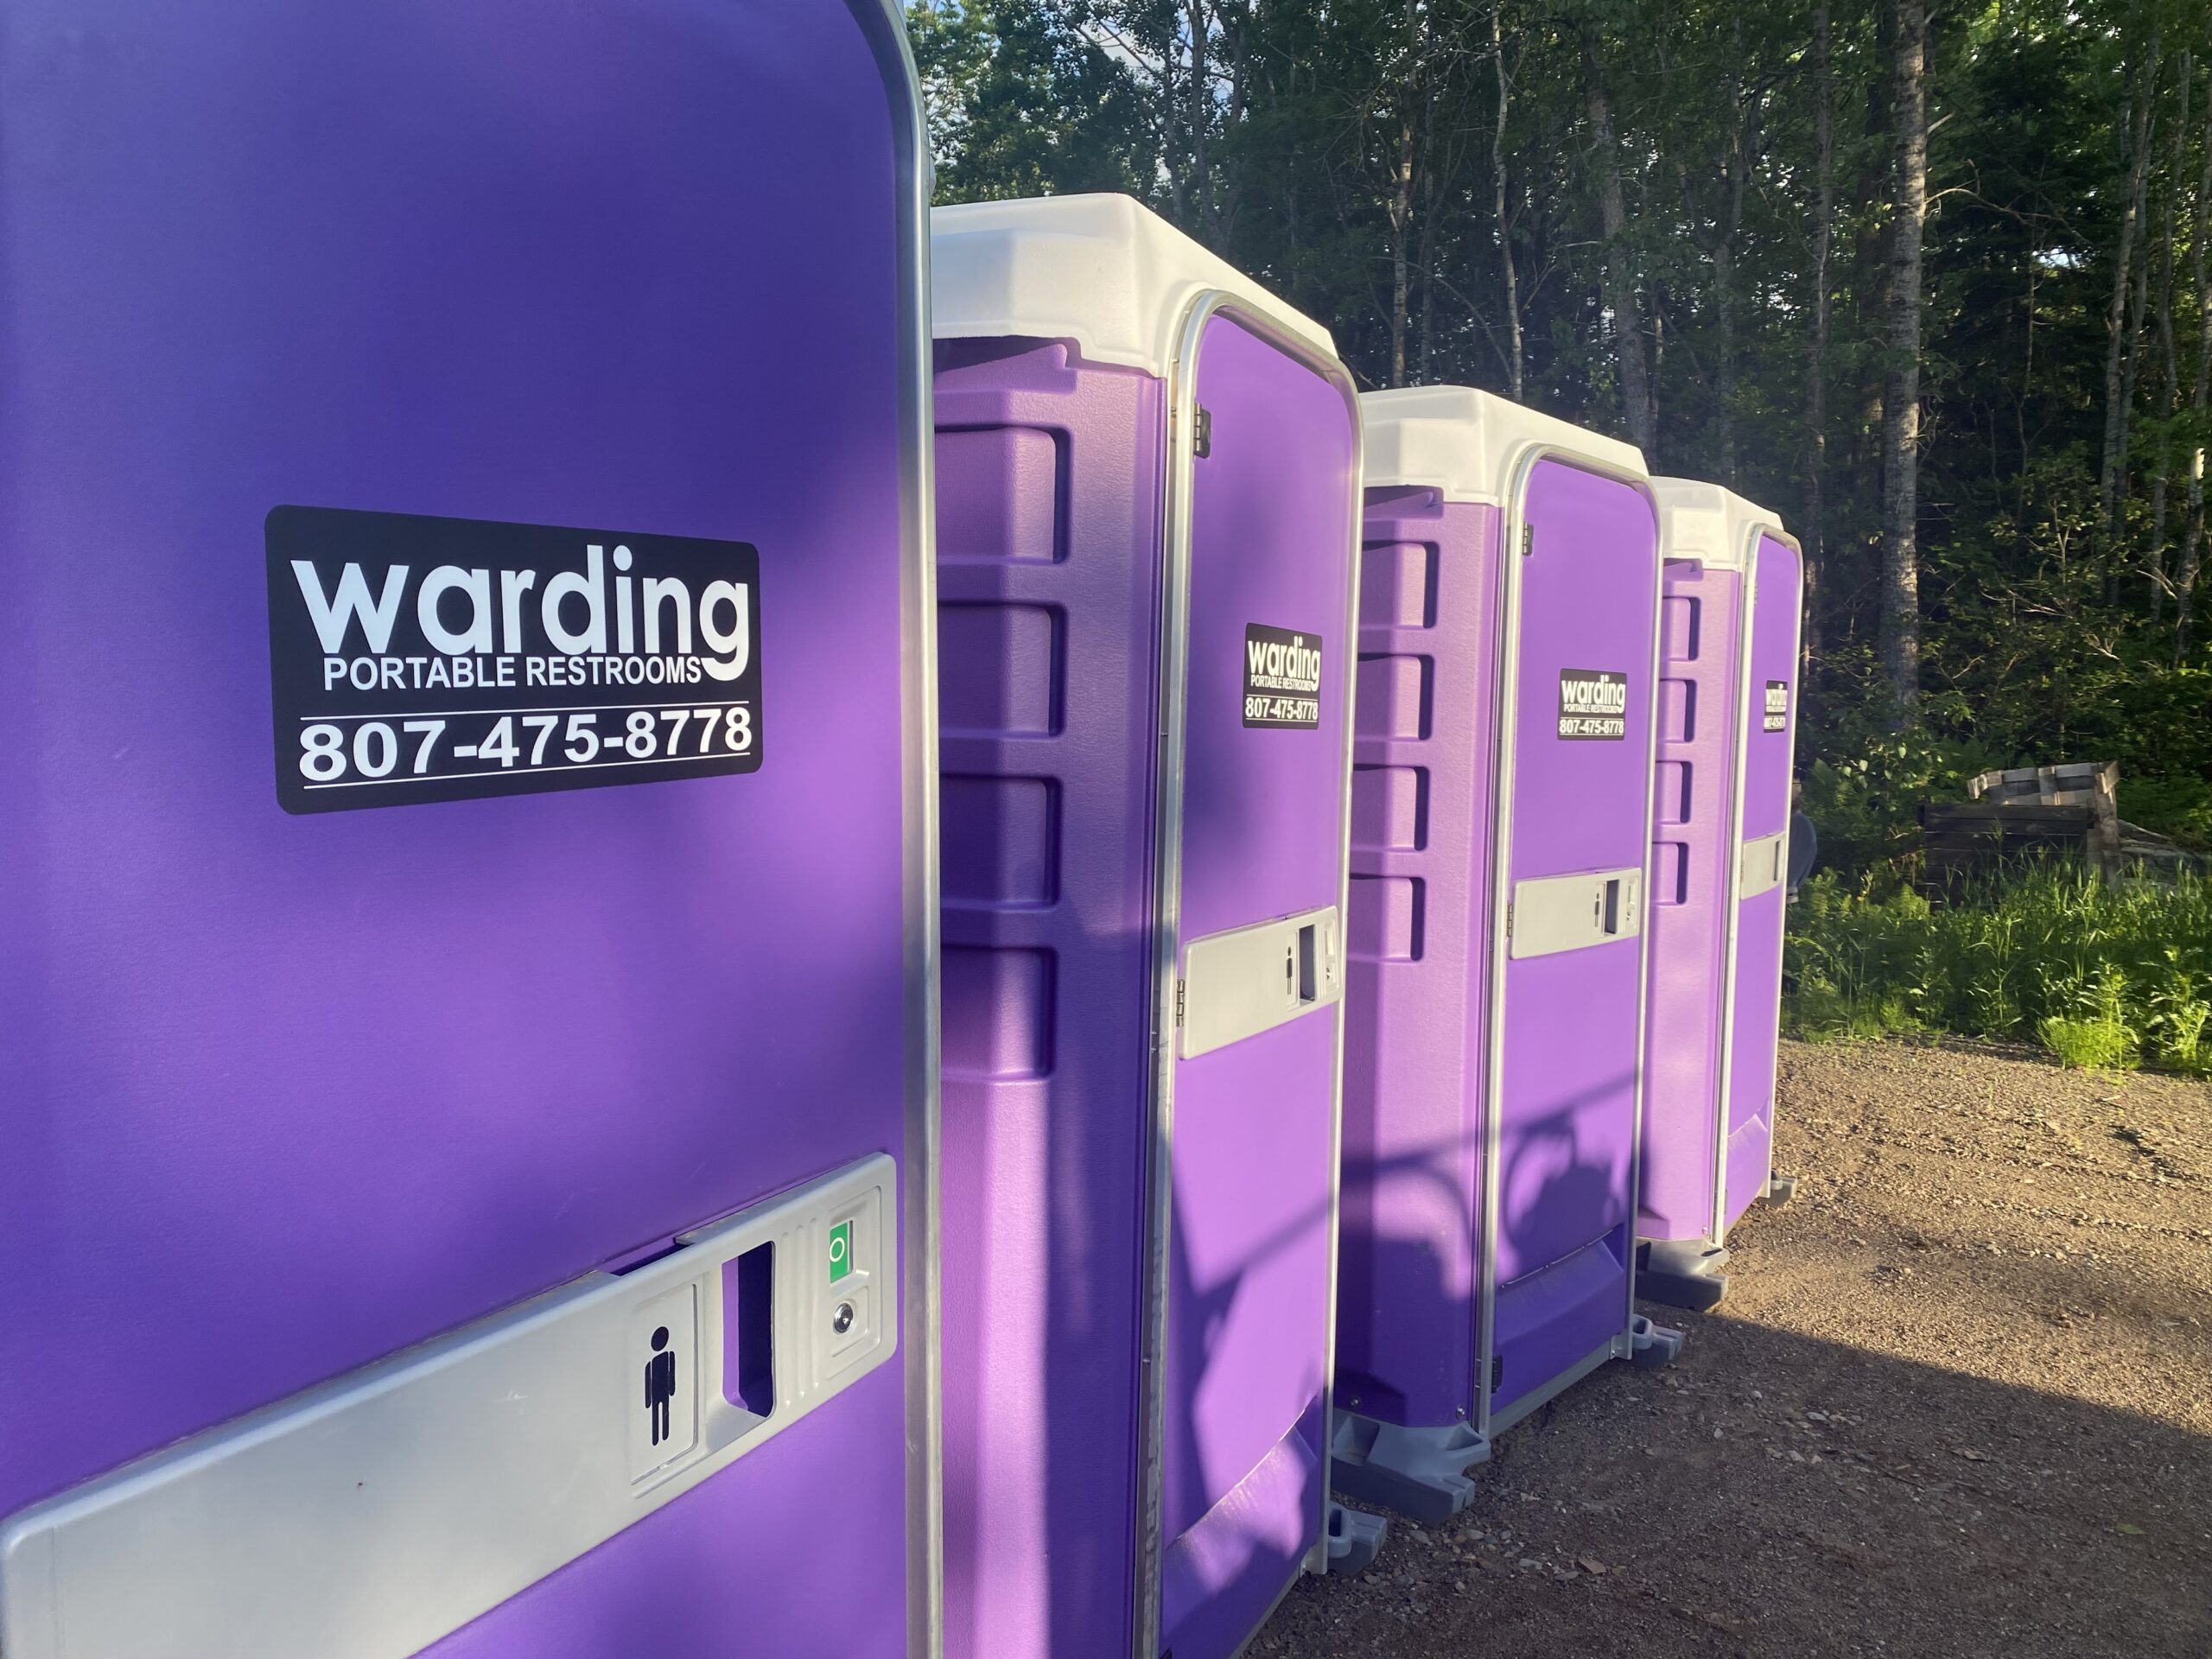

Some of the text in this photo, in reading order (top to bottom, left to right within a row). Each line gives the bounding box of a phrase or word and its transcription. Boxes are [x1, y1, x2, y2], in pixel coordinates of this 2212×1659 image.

[290, 544, 750, 682] warding
[323, 655, 702, 691] PORTABLE RESTROOMS
[1248, 636, 1321, 691] warding
[1250, 674, 1313, 691] PORTABLE RESTROOMS
[1245, 696, 1319, 720] 807-475-8778
[1561, 674, 1626, 714] warding
[299, 706, 753, 782] 807-475-8778
[1559, 719, 1624, 734] 807-475-8778
